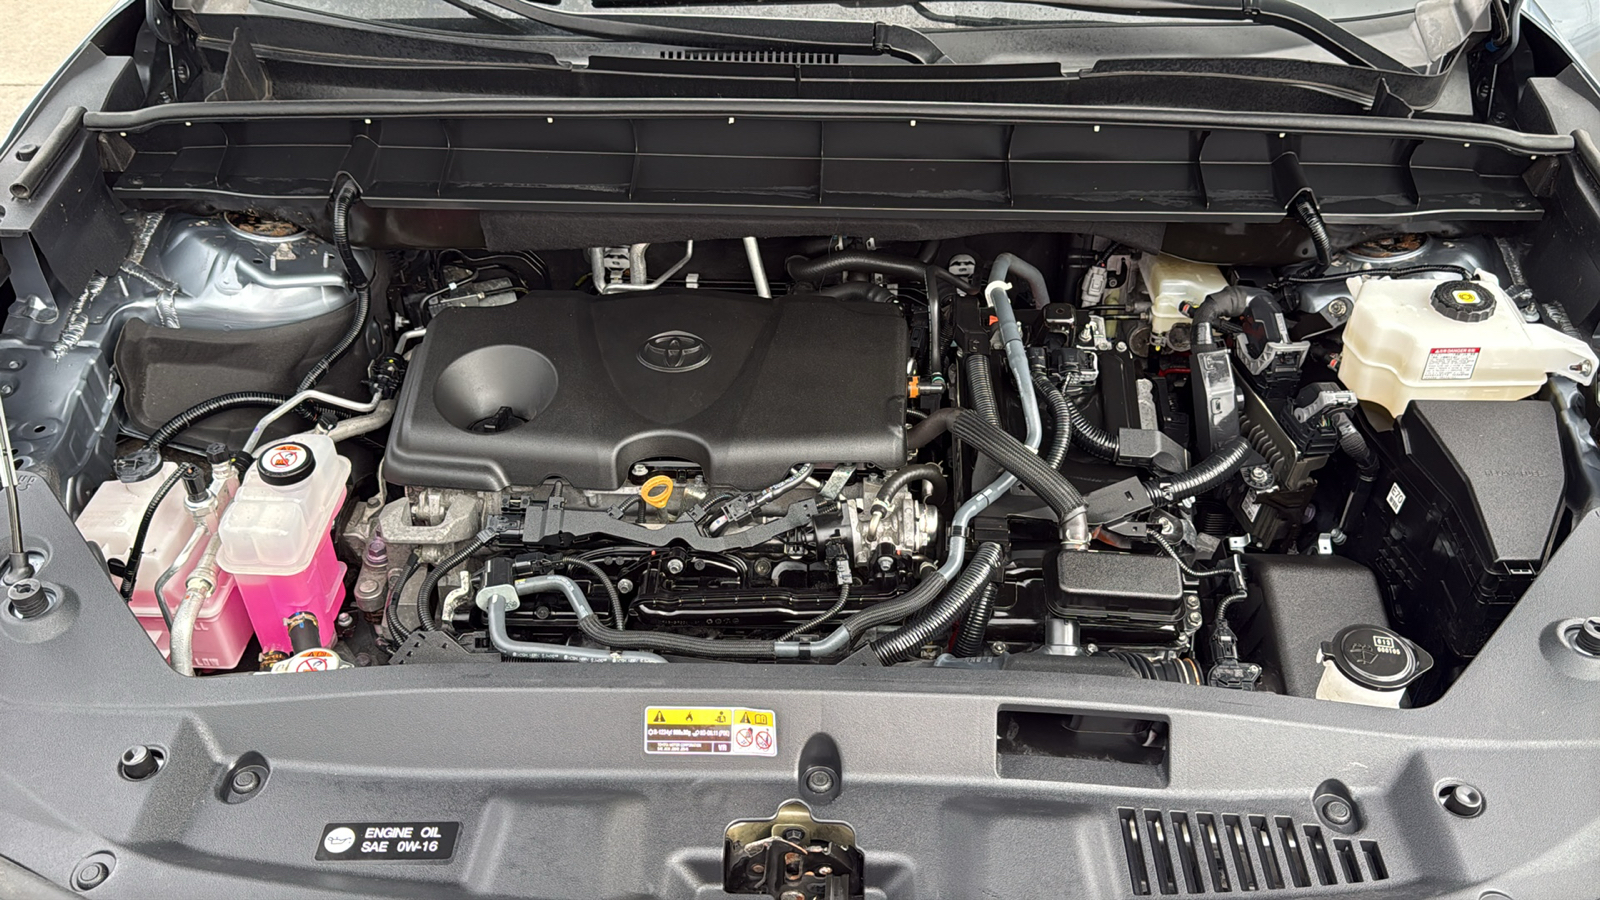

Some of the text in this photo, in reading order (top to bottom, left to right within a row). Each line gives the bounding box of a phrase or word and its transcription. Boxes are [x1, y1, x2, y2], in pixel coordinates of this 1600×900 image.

[194, 657, 220, 666] LOW
[365, 827, 441, 838] ENGINE OIL
[361, 841, 438, 852] SAE 0W-16
